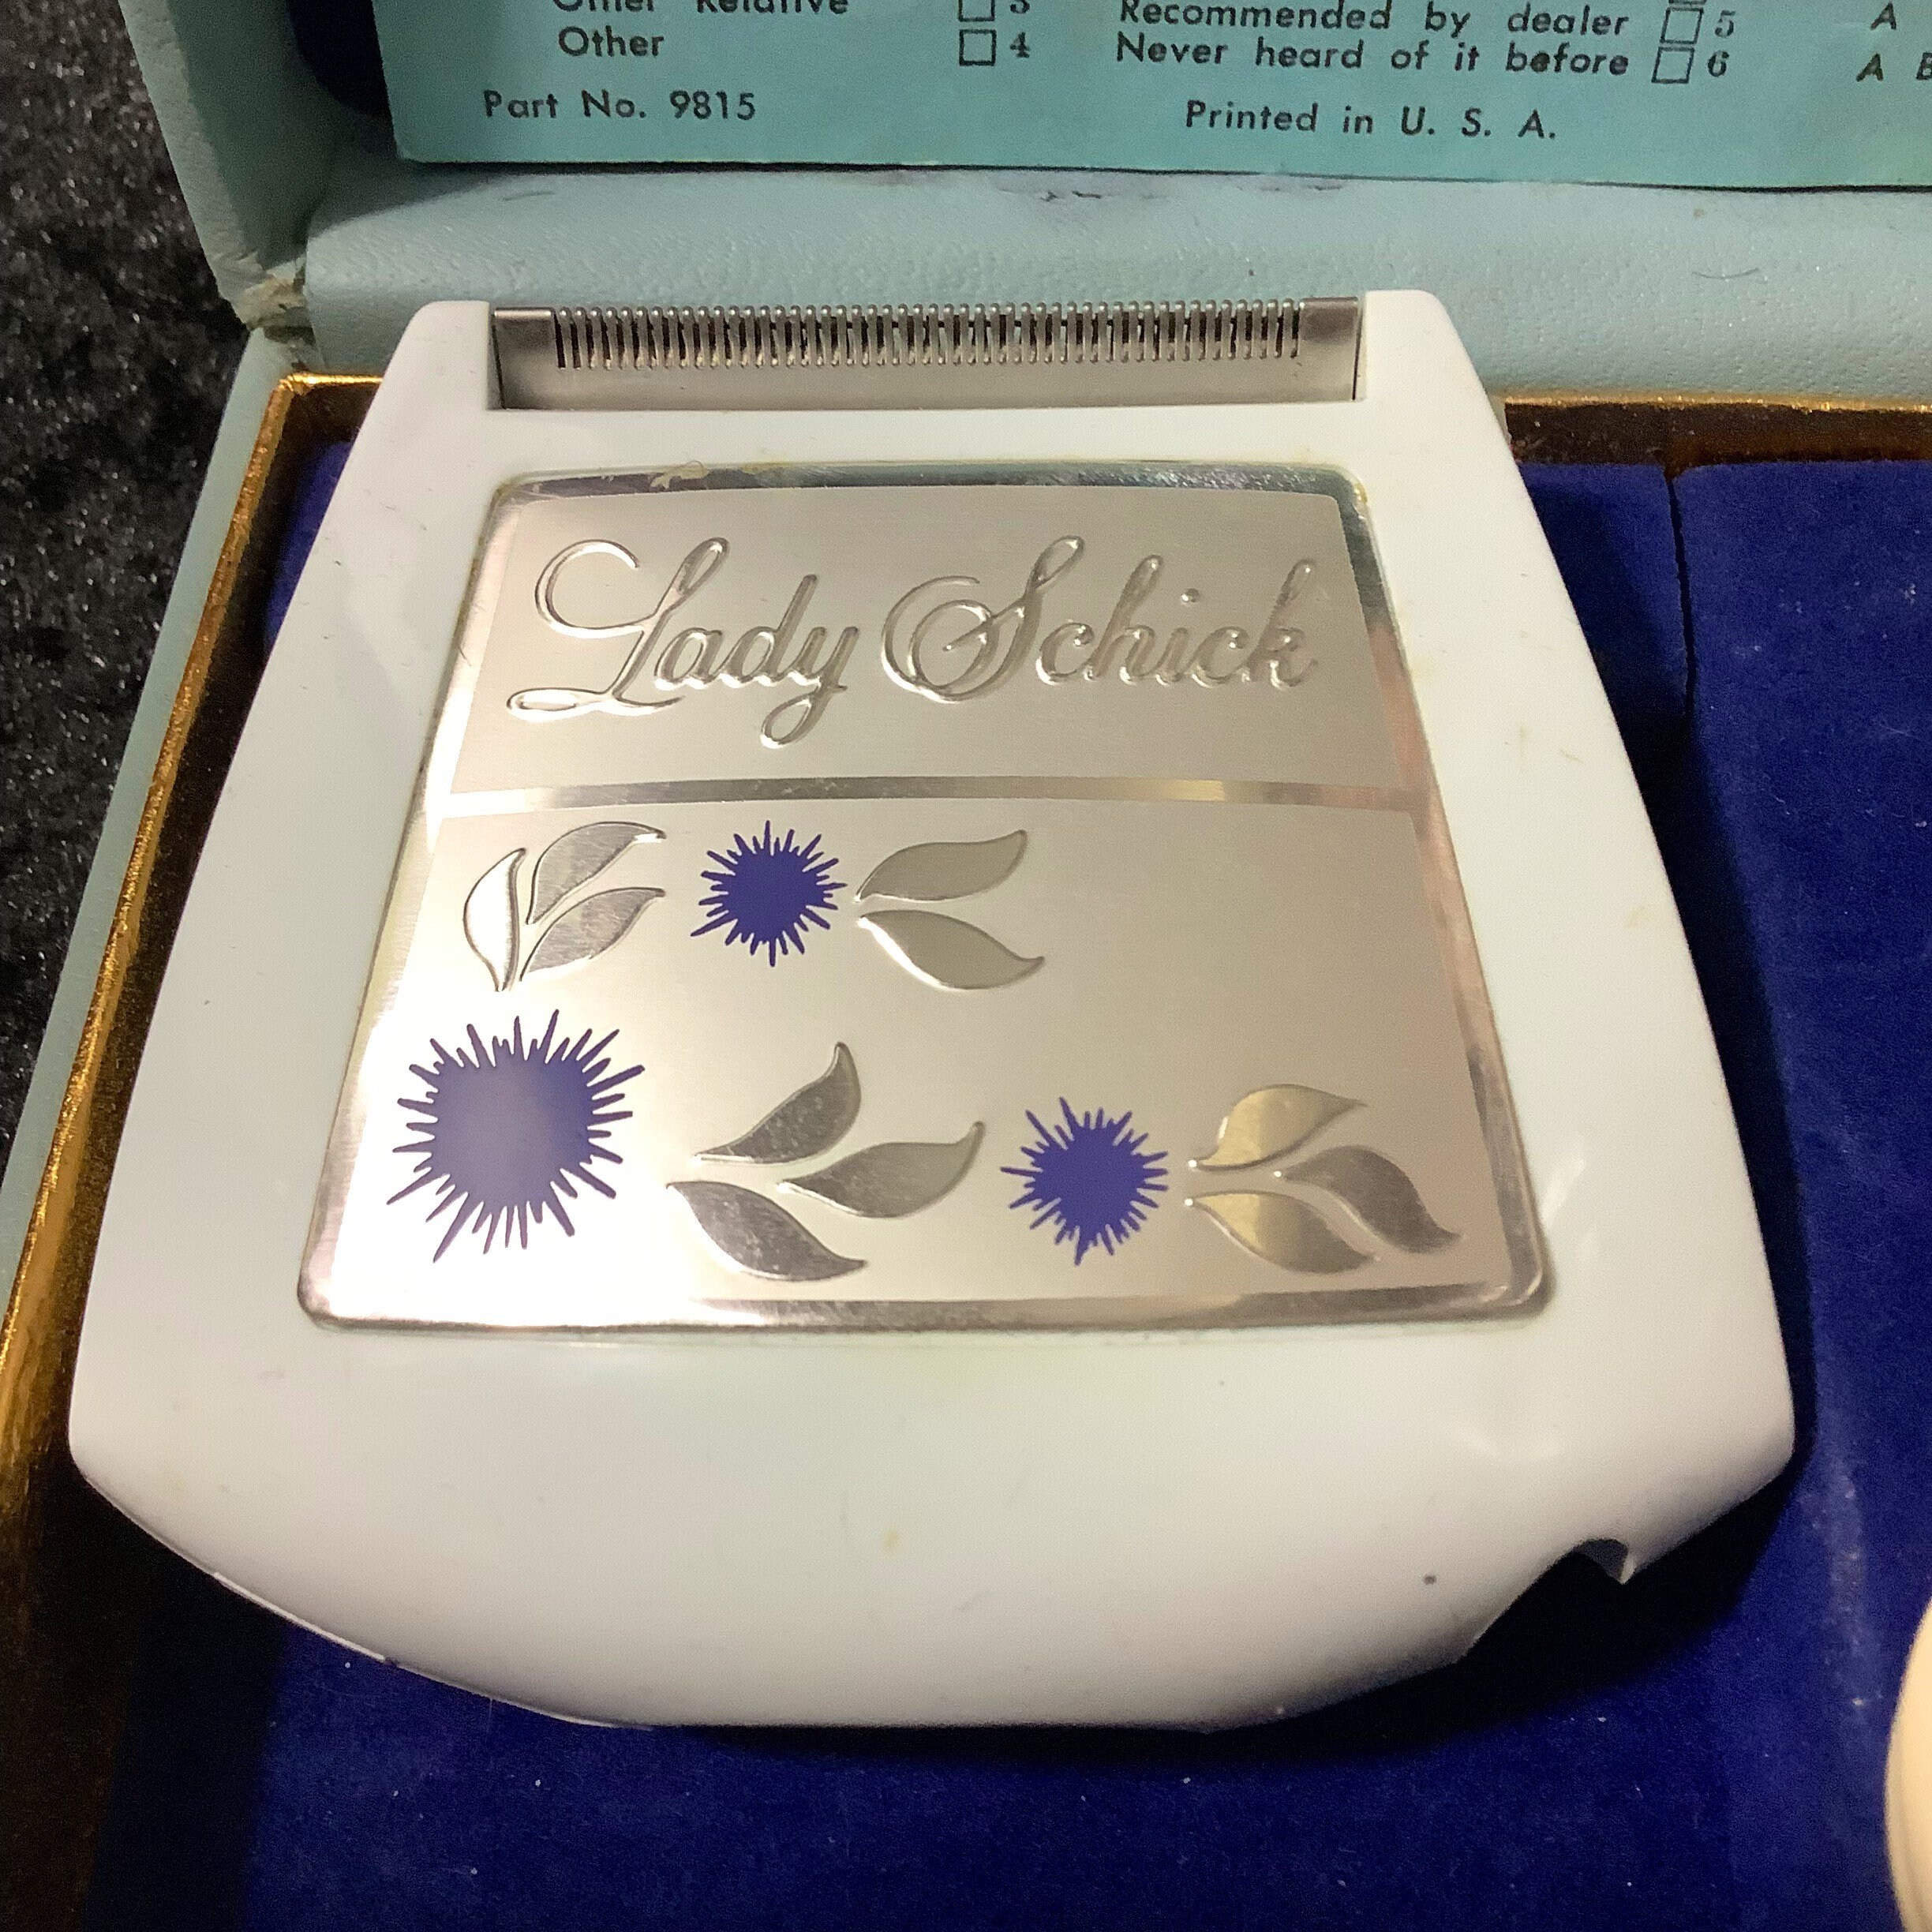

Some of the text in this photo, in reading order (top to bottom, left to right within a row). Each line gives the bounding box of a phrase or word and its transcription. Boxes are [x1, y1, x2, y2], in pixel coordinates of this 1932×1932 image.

[1120, 0, 1630, 39] Recommended by dealer
[1714, 9, 1736, 38] 5
[1870, 2, 1897, 31] A
[558, 24, 665, 58] Other
[1009, 32, 1031, 58] 4
[1116, 31, 1630, 76] Never heard of it before
[1707, 50, 1730, 78] 6
[1855, 53, 1884, 83] A
[483, 88, 756, 121] Part No. 9815
[1185, 99, 1556, 140] Printed in U. S. A.
[507, 535, 1318, 750] Lady Schick
